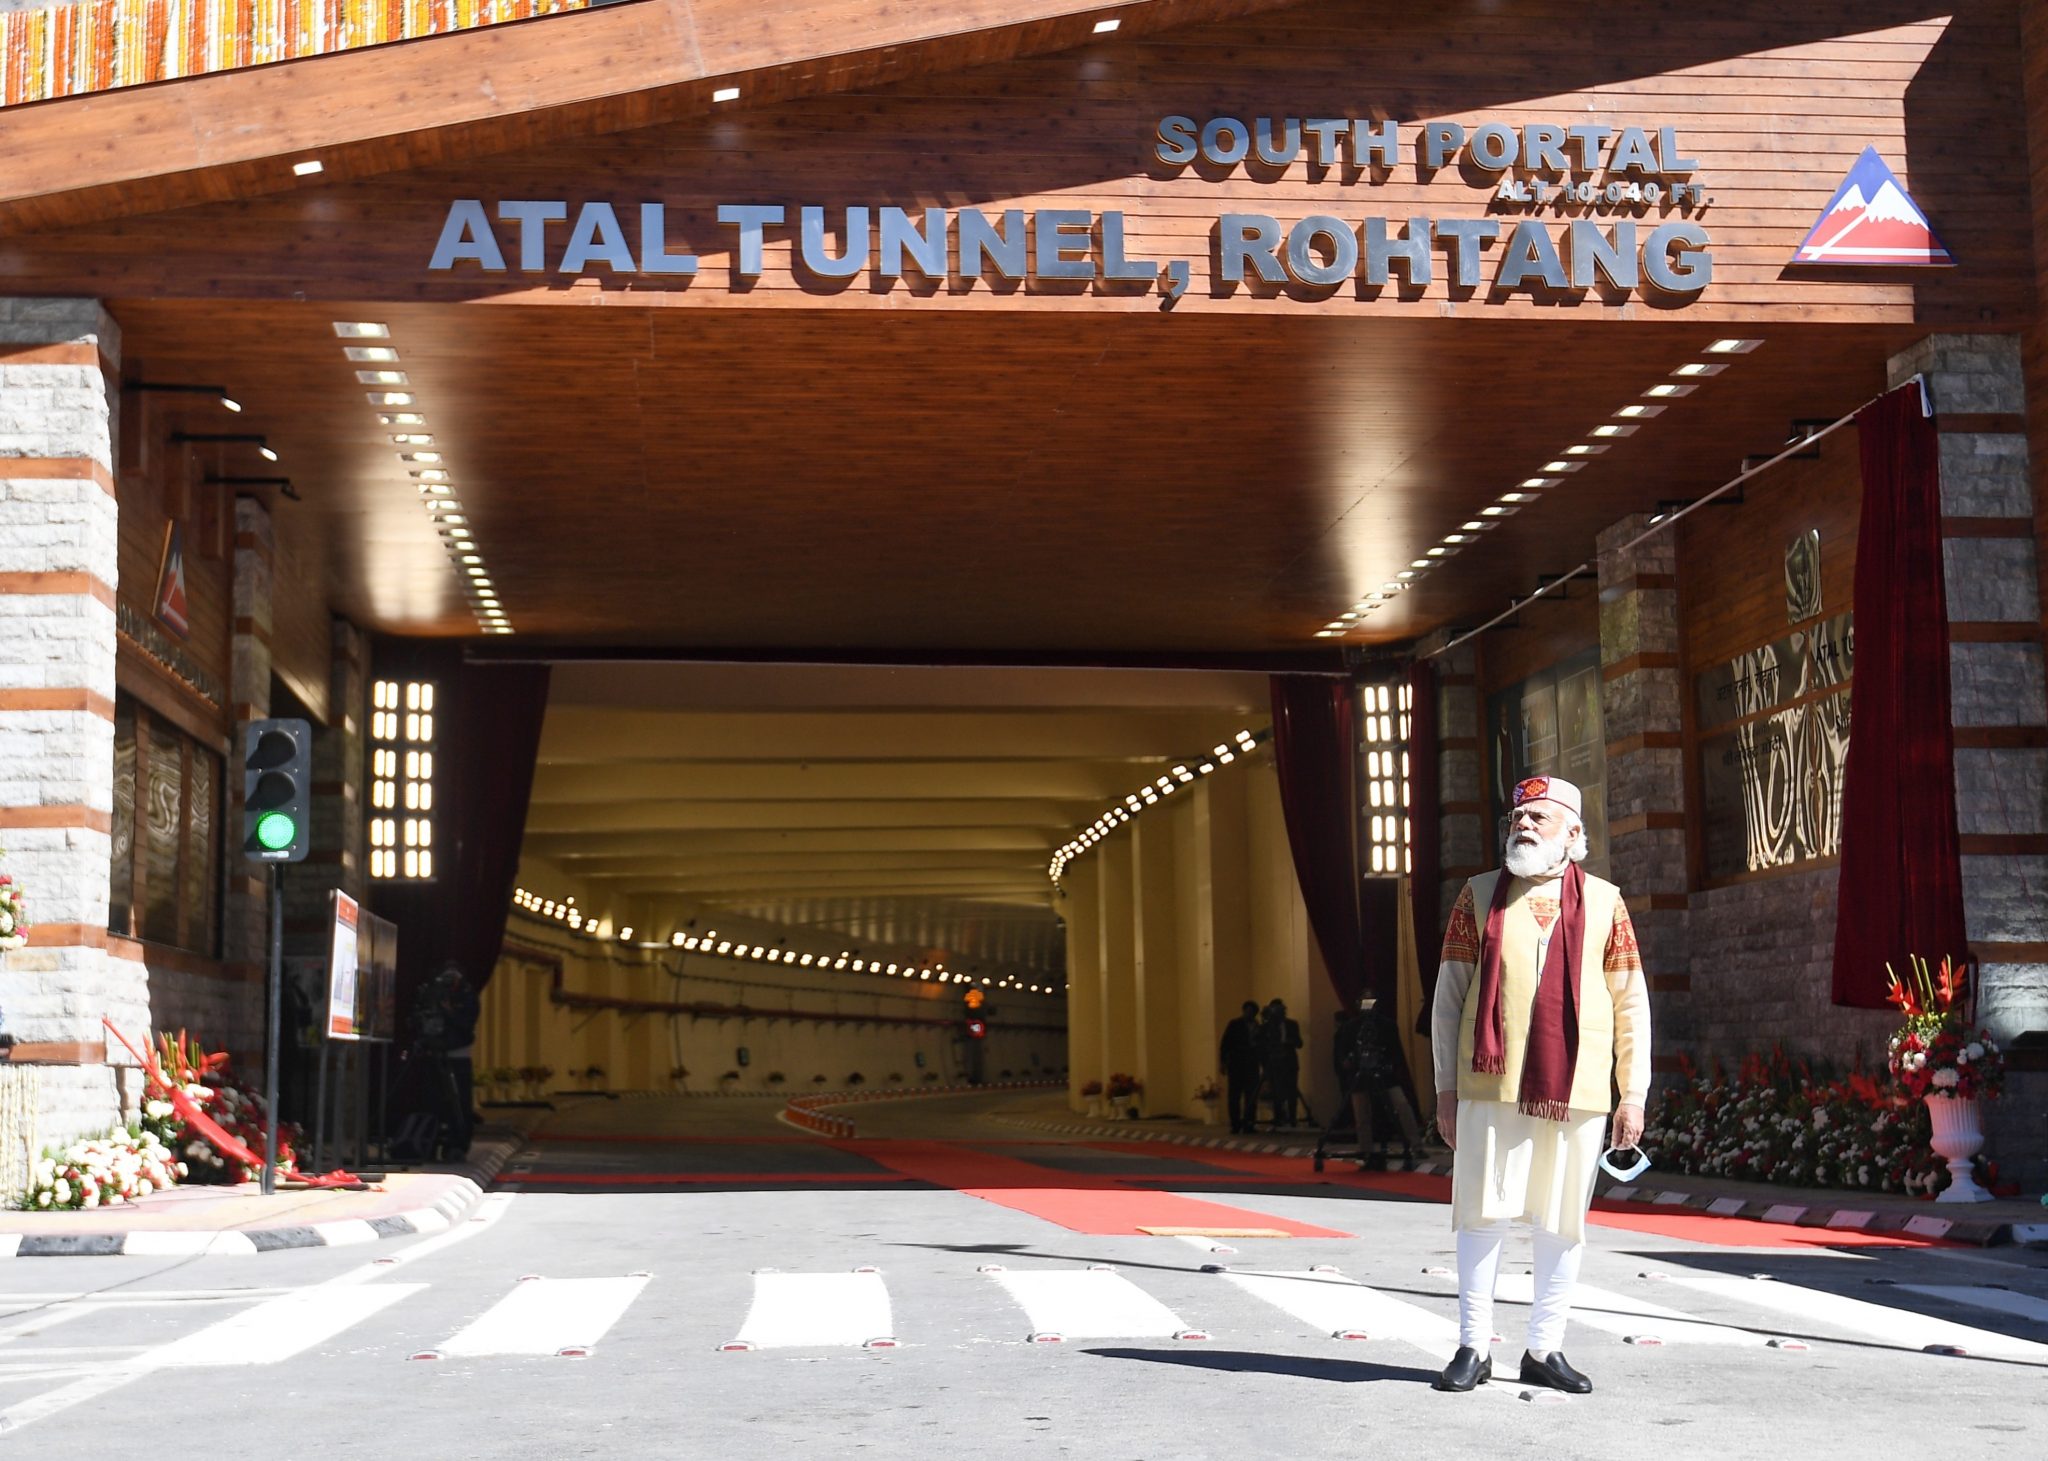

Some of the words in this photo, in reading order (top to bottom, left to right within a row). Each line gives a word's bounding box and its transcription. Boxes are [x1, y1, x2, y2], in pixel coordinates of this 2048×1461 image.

[1155, 115, 1399, 169] SOUTH
[1424, 122, 1700, 174] PORTAL
[1496, 179, 1551, 203] ALT.
[1668, 182, 1715, 205] FT.
[428, 199, 699, 276] ATAL
[717, 205, 1190, 298] TUNNEL,
[1219, 213, 1714, 292] ROHTANG
